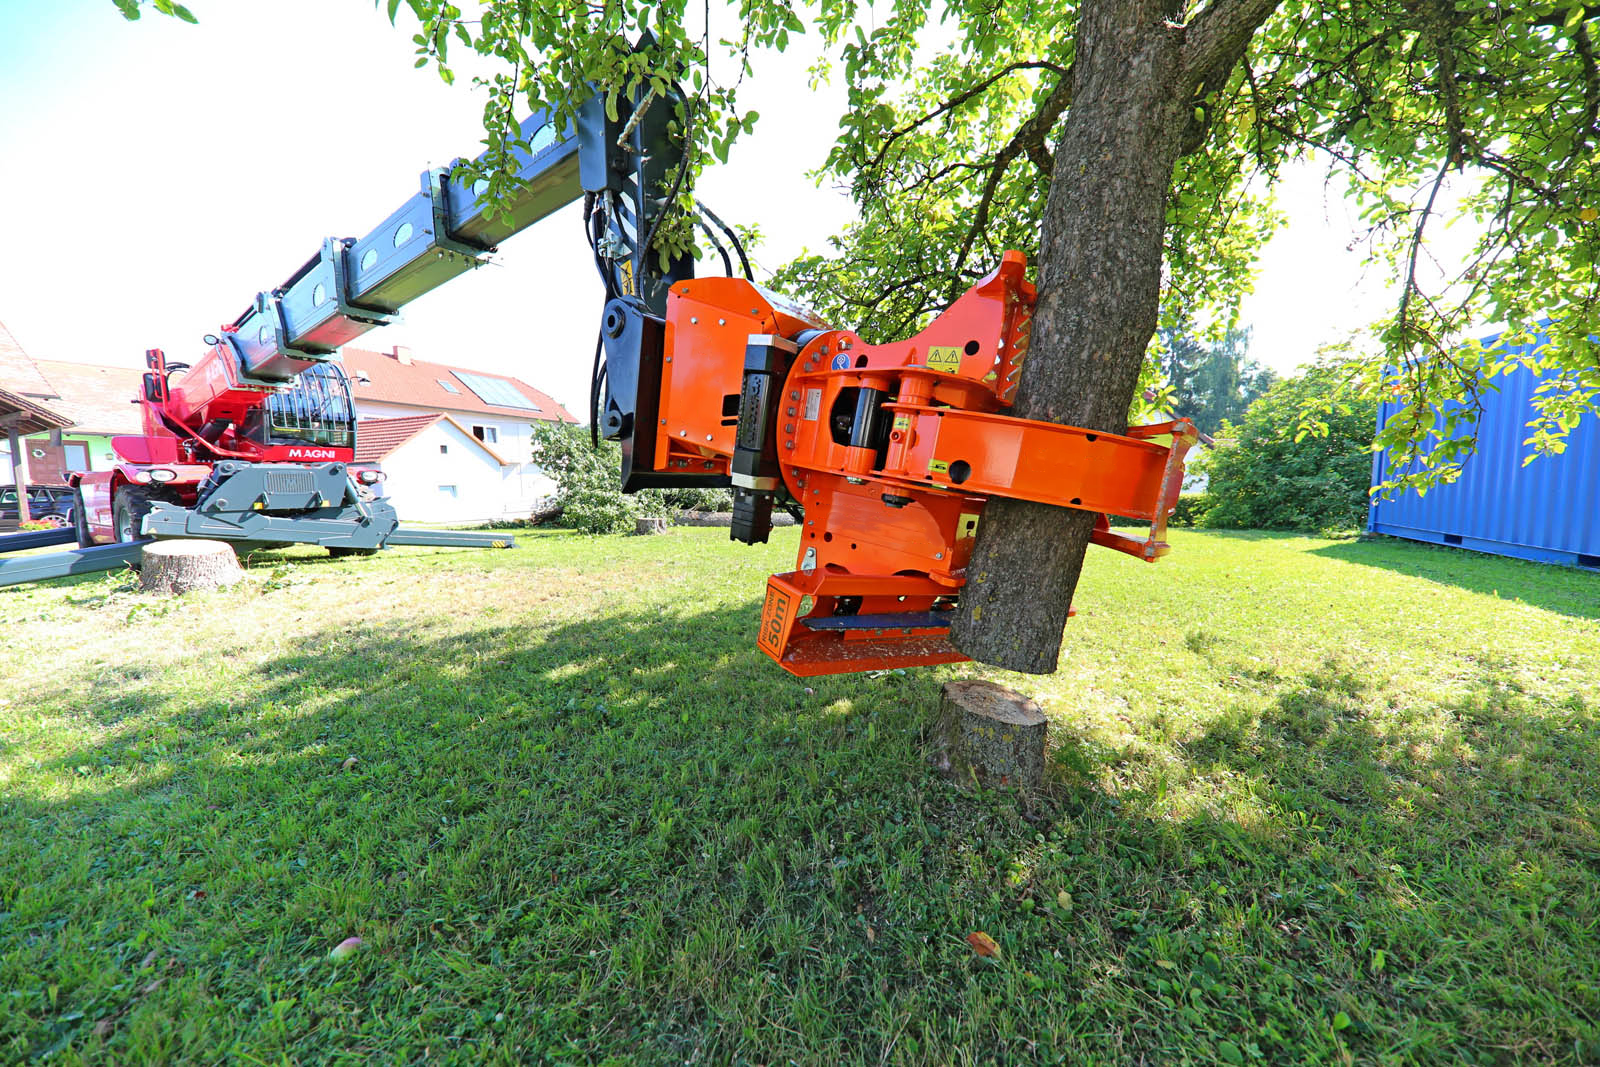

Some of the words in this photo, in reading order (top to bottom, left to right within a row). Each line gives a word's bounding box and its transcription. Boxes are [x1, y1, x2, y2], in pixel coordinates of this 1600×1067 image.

[289, 449, 335, 459] MAGNI
[767, 591, 775, 618] ZONE
[768, 598, 786, 648] 50m
